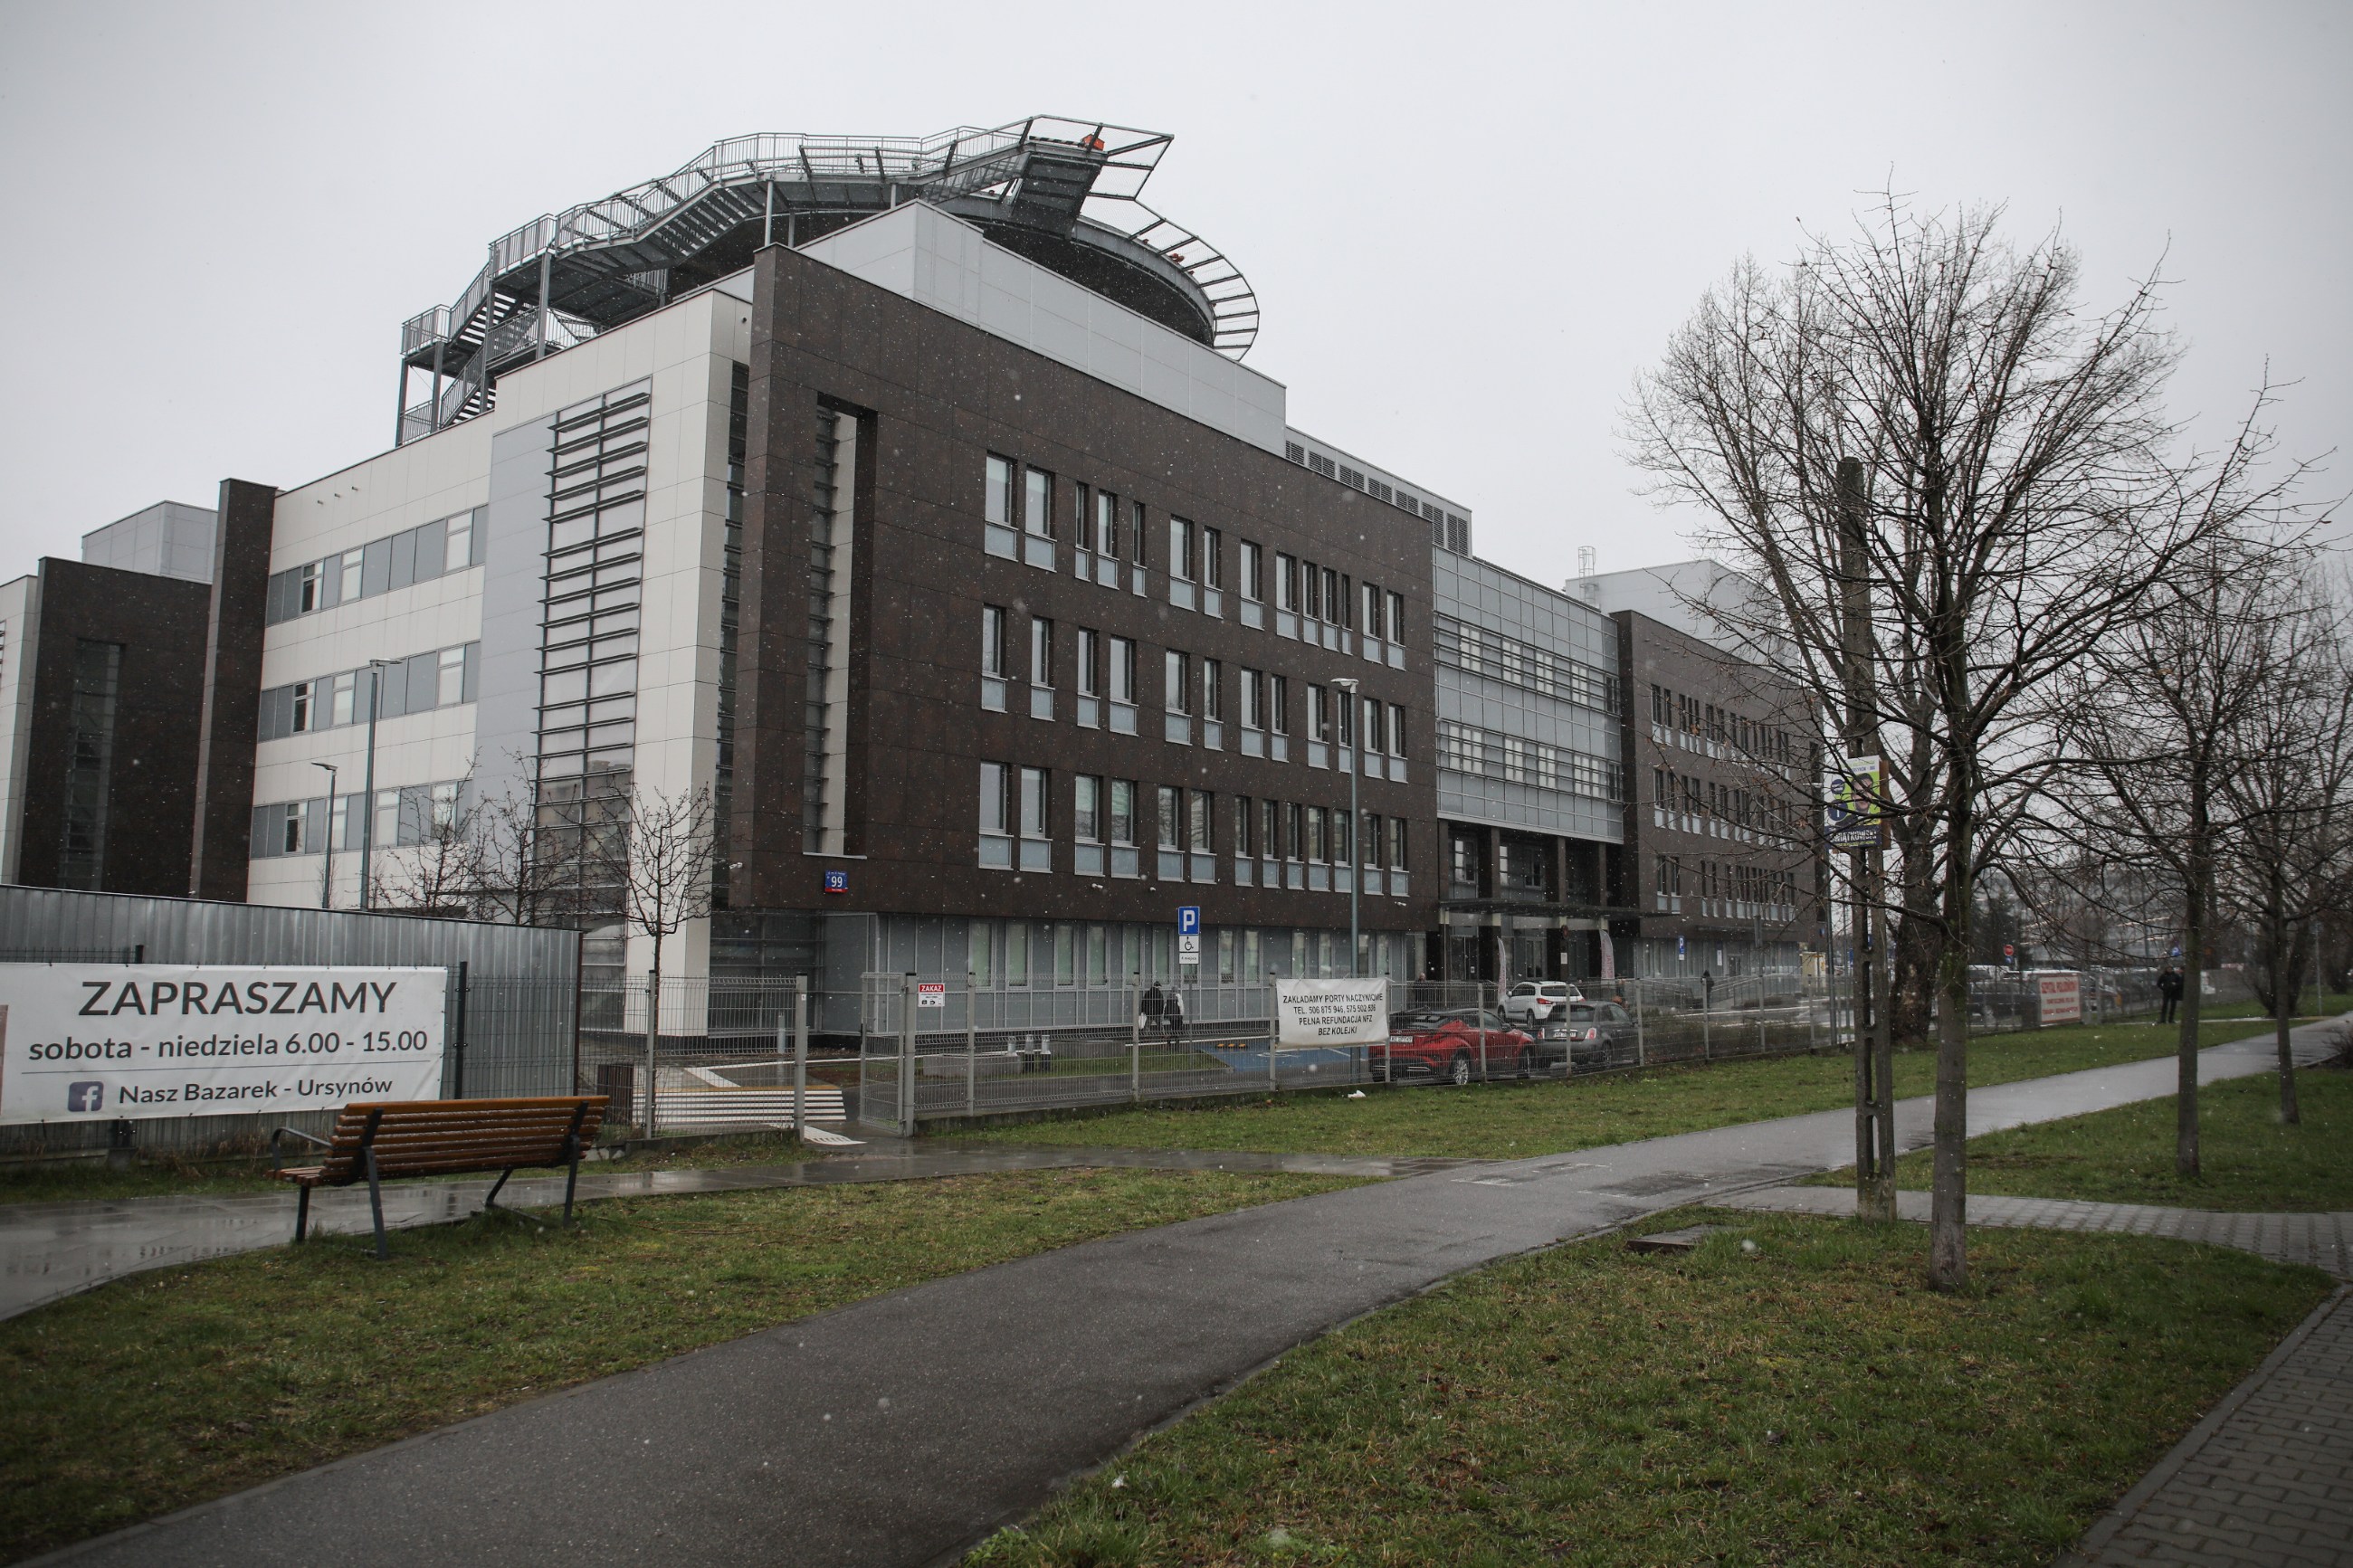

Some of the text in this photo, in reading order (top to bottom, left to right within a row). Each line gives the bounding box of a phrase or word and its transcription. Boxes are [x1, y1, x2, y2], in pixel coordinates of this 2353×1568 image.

[831, 876, 843, 888] 99
[1183, 909, 1196, 932] P
[79, 981, 397, 1016] ZAPRASZAMY
[1324, 994, 1345, 1003] PORTY
[1293, 1006, 1308, 1014] TEL.
[1309, 1006, 1320, 1014] 506
[1321, 1006, 1332, 1014] 875
[1346, 1004, 1357, 1013] 575
[1299, 1014, 1373, 1026] PEŁNA REFUNDACJA NFZ
[1318, 1026, 1358, 1036] BEZ KOLEJKI
[28, 1036, 133, 1060] sobota
[158, 1033, 278, 1058] niedziela
[285, 1032, 340, 1054] 6.00
[363, 1031, 428, 1052] 15.00
[119, 1086, 178, 1104] Nasz
[184, 1080, 278, 1101] Bazarek
[298, 1077, 393, 1098] Ursynów
